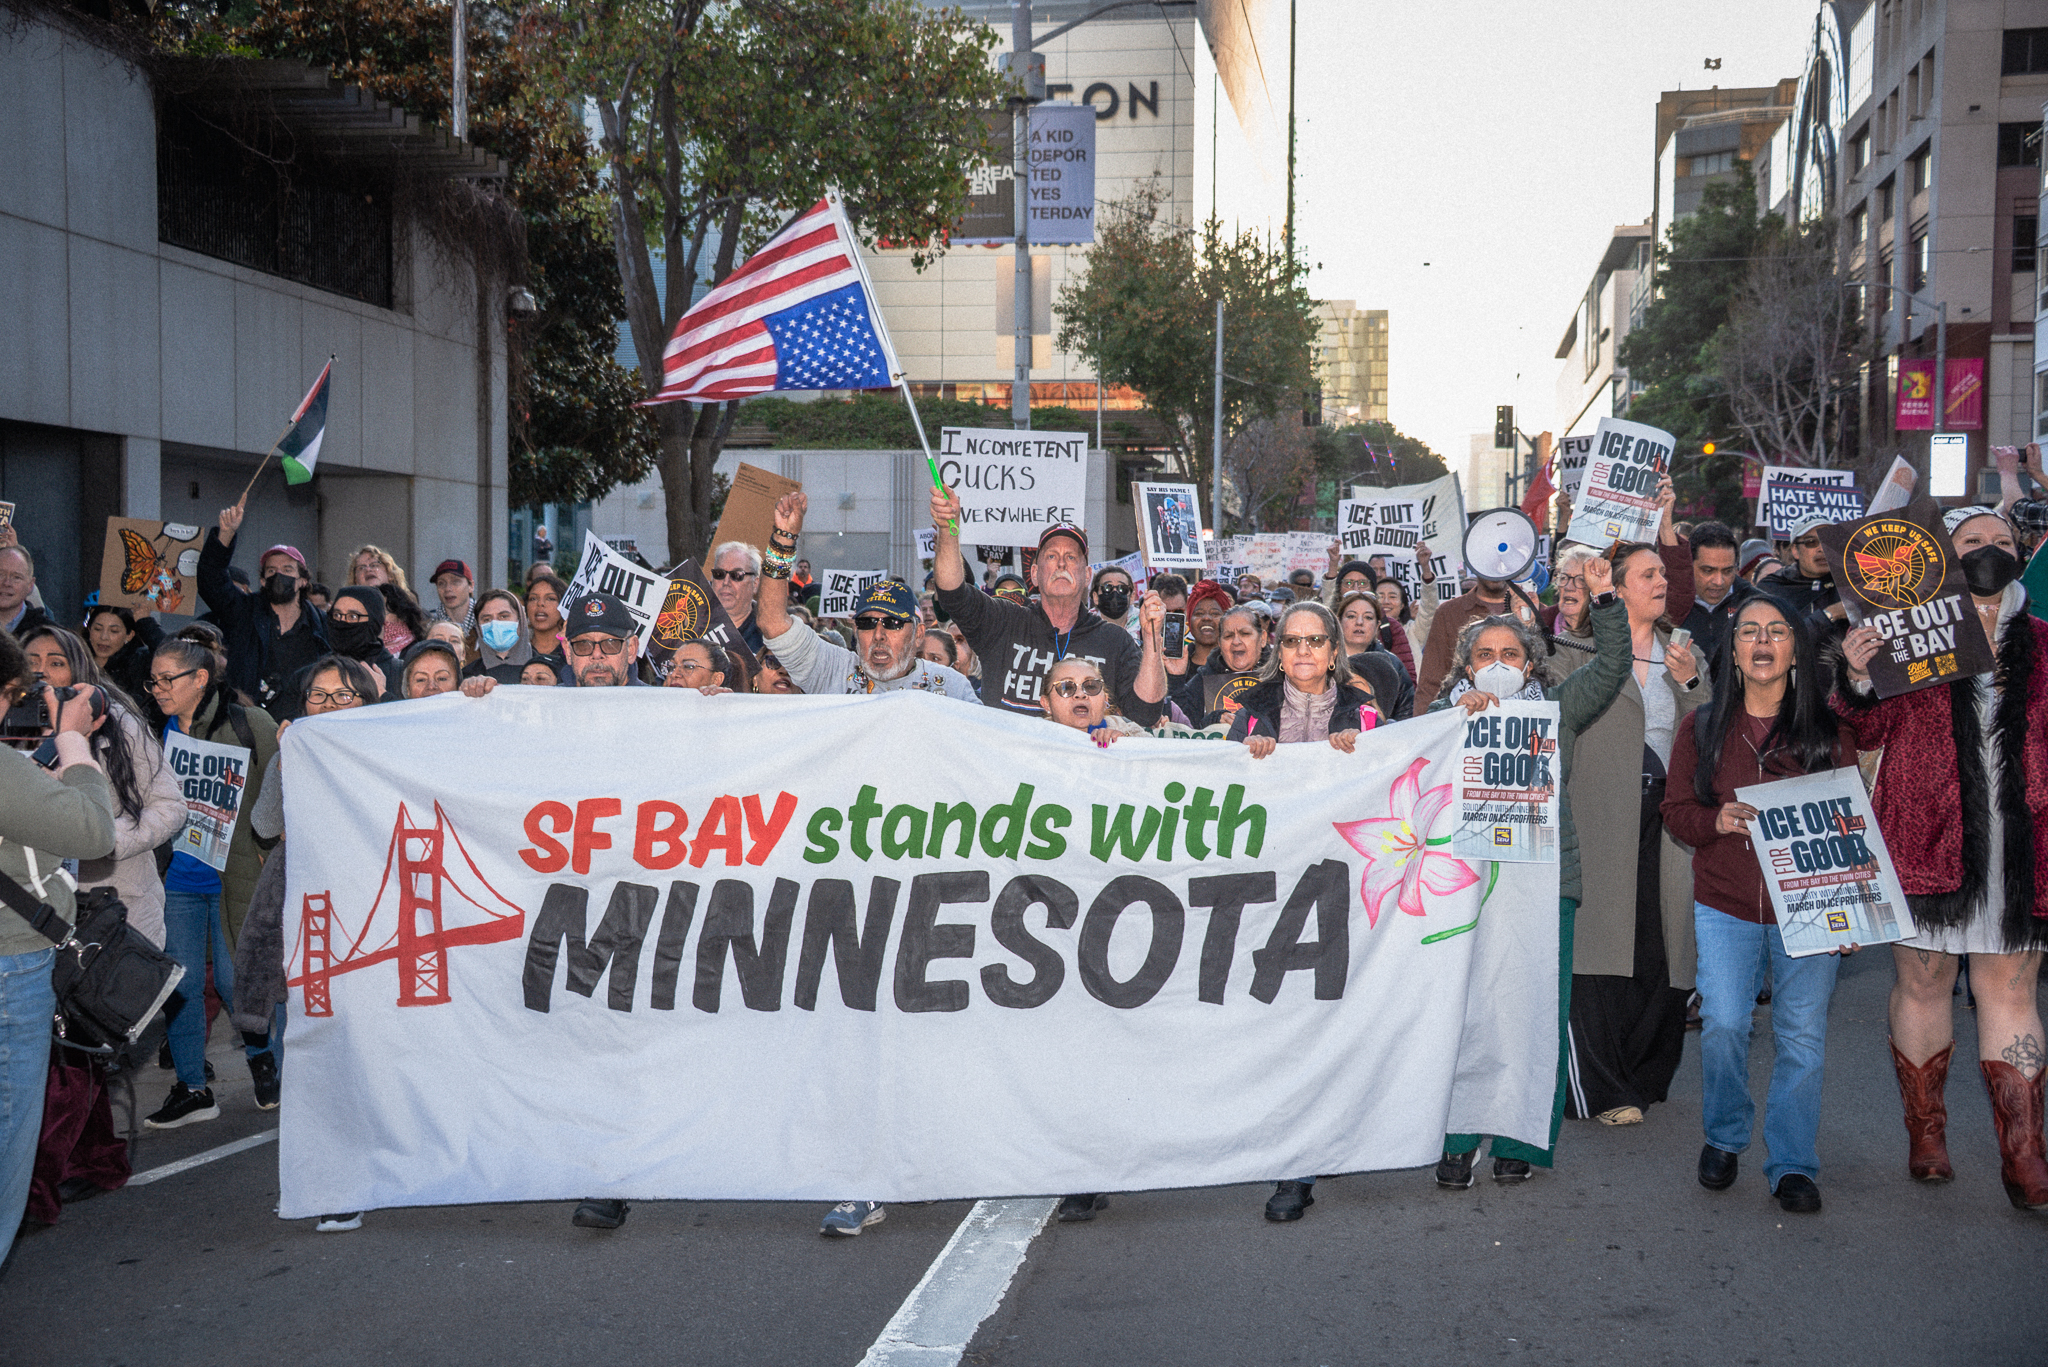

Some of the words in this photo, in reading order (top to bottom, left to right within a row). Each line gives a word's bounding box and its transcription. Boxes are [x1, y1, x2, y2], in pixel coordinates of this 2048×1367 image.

[1031, 130, 1041, 143] A
[1047, 130, 1073, 143] KID
[1031, 150, 1086, 162] DEPOR
[1031, 168, 1062, 181] TED
[1030, 188, 1061, 200] YES
[1030, 207, 1093, 220] TERDAY
[941, 430, 1084, 463] INCOMPETENT
[1598, 431, 1634, 462] ICE
[1633, 438, 1671, 467] OUT
[939, 460, 1036, 491] CUCKS
[1591, 462, 1611, 485] FOR
[1771, 488, 1817, 504] HATE
[1819, 492, 1861, 508] WILL
[959, 505, 1076, 523] VERYWHERE
[1348, 504, 1374, 526] ICE
[1380, 504, 1413, 525] OUT
[1772, 503, 1810, 517] NOT
[1814, 506, 1863, 522] MAKE
[1773, 518, 1795, 532] US
[620, 540, 635, 551] OUT
[1342, 528, 1371, 549] FOR
[1374, 527, 1418, 549] GOOD!
[1863, 525, 1879, 538] WE
[1881, 524, 1906, 534] KEEP
[1908, 529, 1922, 541] US
[1921, 540, 1938, 563] SAFE
[1220, 566, 1231, 577] ICE
[1234, 566, 1249, 577] OUT
[1392, 561, 1410, 582] ICE
[598, 563, 655, 607] OUT
[830, 573, 854, 594] ICE
[691, 590, 704, 606] SAFE
[824, 596, 848, 614] FOR
[1863, 609, 1910, 642] ICE
[1910, 594, 1964, 630] OUT
[1890, 650, 1910, 664] THE
[1909, 624, 1957, 658] BAY
[1892, 637, 1905, 650] OF
[1013, 643, 1106, 674] THT
[1907, 659, 1928, 676] Bay
[1464, 716, 1502, 749] ICE
[1505, 716, 1552, 750] OUT
[170, 746, 201, 776] ICE
[202, 755, 243, 780] OUT
[1463, 755, 1483, 783] FOR
[1484, 752, 1550, 787] GOOD
[184, 778, 238, 810] GOOD
[1466, 790, 1482, 798] FROM
[1506, 792, 1516, 800] THE
[1529, 793, 1546, 801] CITIES
[1462, 803, 1494, 812] SOLIDARITY
[1494, 804, 1508, 813] WITH
[1462, 812, 1489, 821] MARCH
[1488, 813, 1498, 822] ON
[1498, 813, 1510, 823] ICE
[1509, 814, 1548, 825] PROFITEERS
[518, 797, 622, 875] SF
[633, 790, 798, 870] BAY
[803, 782, 1073, 864] stands
[1090, 781, 1268, 863] with
[1758, 804, 1805, 842] ICE
[1801, 796, 1853, 835] OUT
[1769, 847, 1796, 875] FOR
[1790, 834, 1871, 874] GOOD
[1783, 881, 1799, 889] FROM
[1800, 879, 1810, 887] THE
[1810, 877, 1821, 885] BAY
[1821, 876, 1829, 884] TO
[1829, 874, 1839, 882] THE
[1839, 872, 1854, 881] TWIN
[1854, 870, 1872, 880] CITIES
[1783, 891, 1818, 903] SOLIDARITY
[1818, 888, 1836, 899] WITH
[1787, 900, 1815, 913] MARCH
[1815, 898, 1826, 909] ON
[1827, 897, 1840, 908] ICE
[1840, 892, 1882, 906] PROFITEERS
[522, 858, 1350, 1013] MINNESOTA
